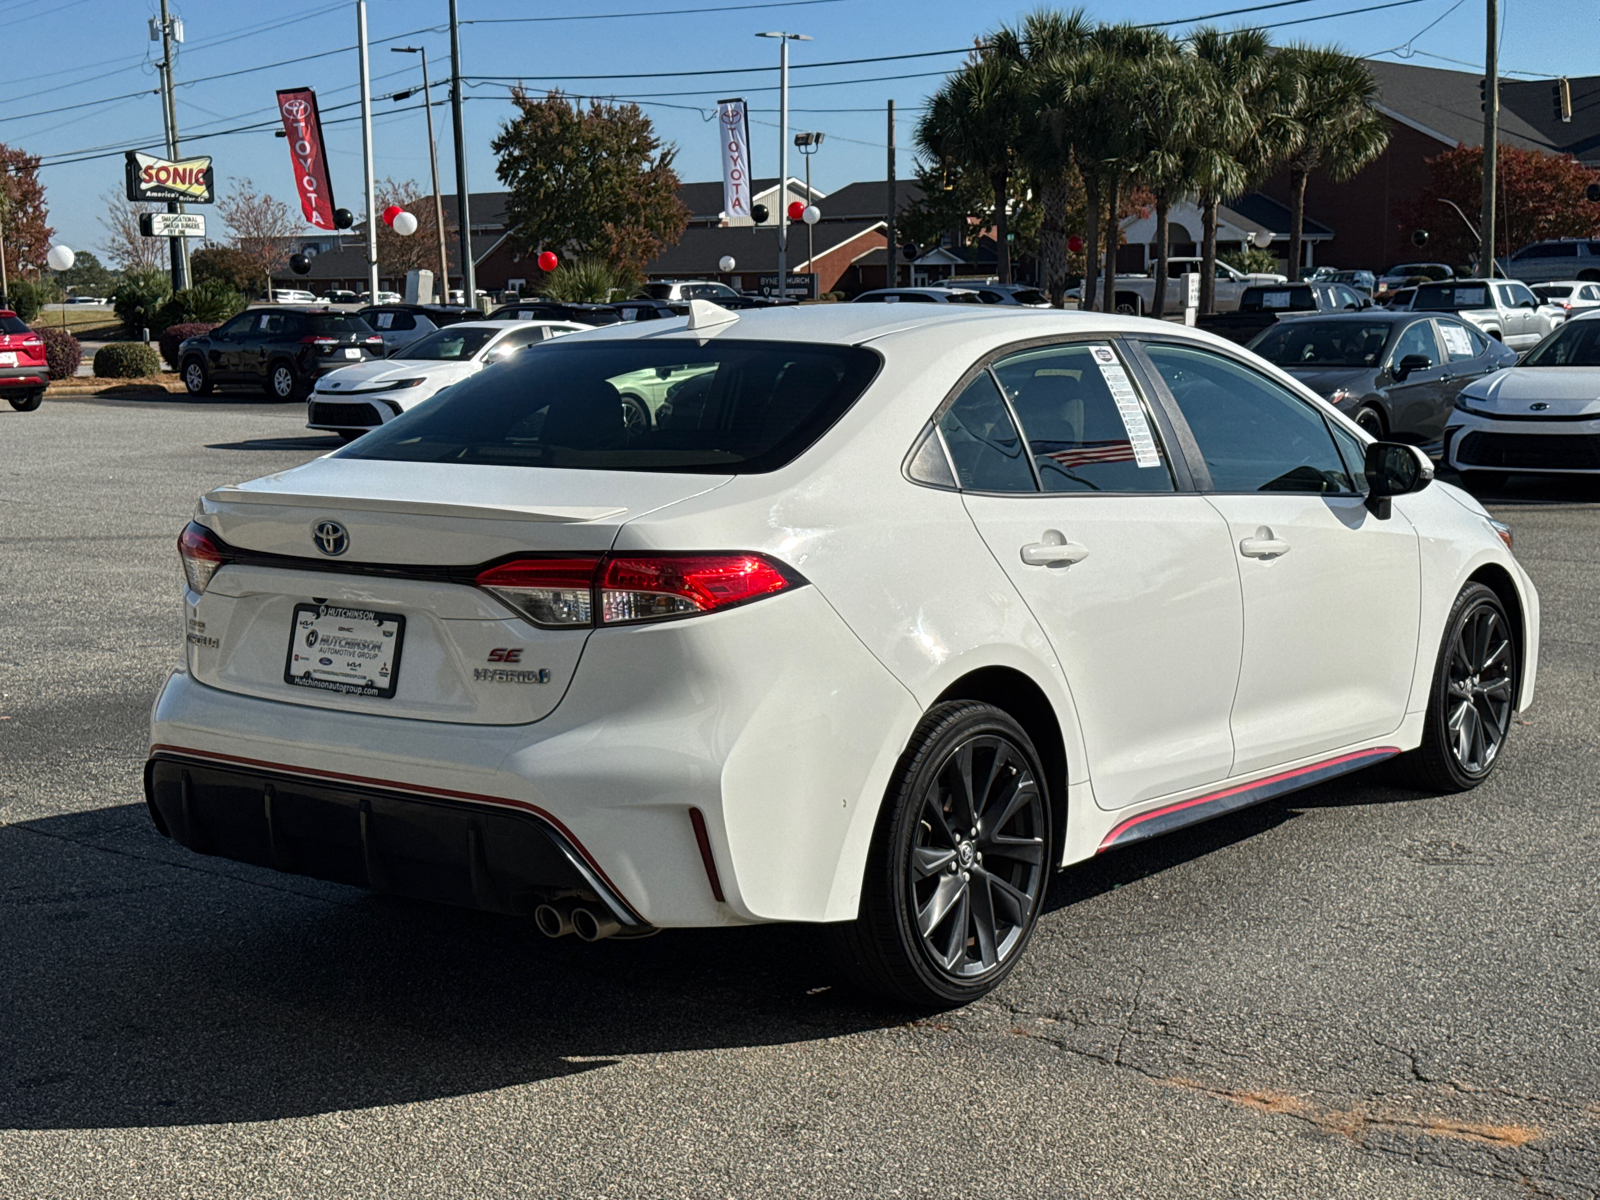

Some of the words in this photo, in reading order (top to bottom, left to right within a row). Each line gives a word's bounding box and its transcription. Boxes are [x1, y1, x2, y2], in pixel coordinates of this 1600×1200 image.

[143, 165, 206, 186] SONIC
[293, 122, 325, 225] TOYOTA
[728, 127, 742, 209] TOYOTA
[145, 190, 180, 198] America's
[761, 277, 779, 285] BYNE
[787, 276, 810, 284] HURCH
[327, 608, 375, 620] HUTCHINSON
[319, 635, 383, 652] HUTCHINSON
[318, 647, 356, 657] AUTOMOTIVE
[357, 651, 378, 660] GROUP
[487, 648, 524, 663] SE
[474, 668, 537, 684] HYBRID
[294, 677, 379, 695] Hutchinsonautogroup.com
